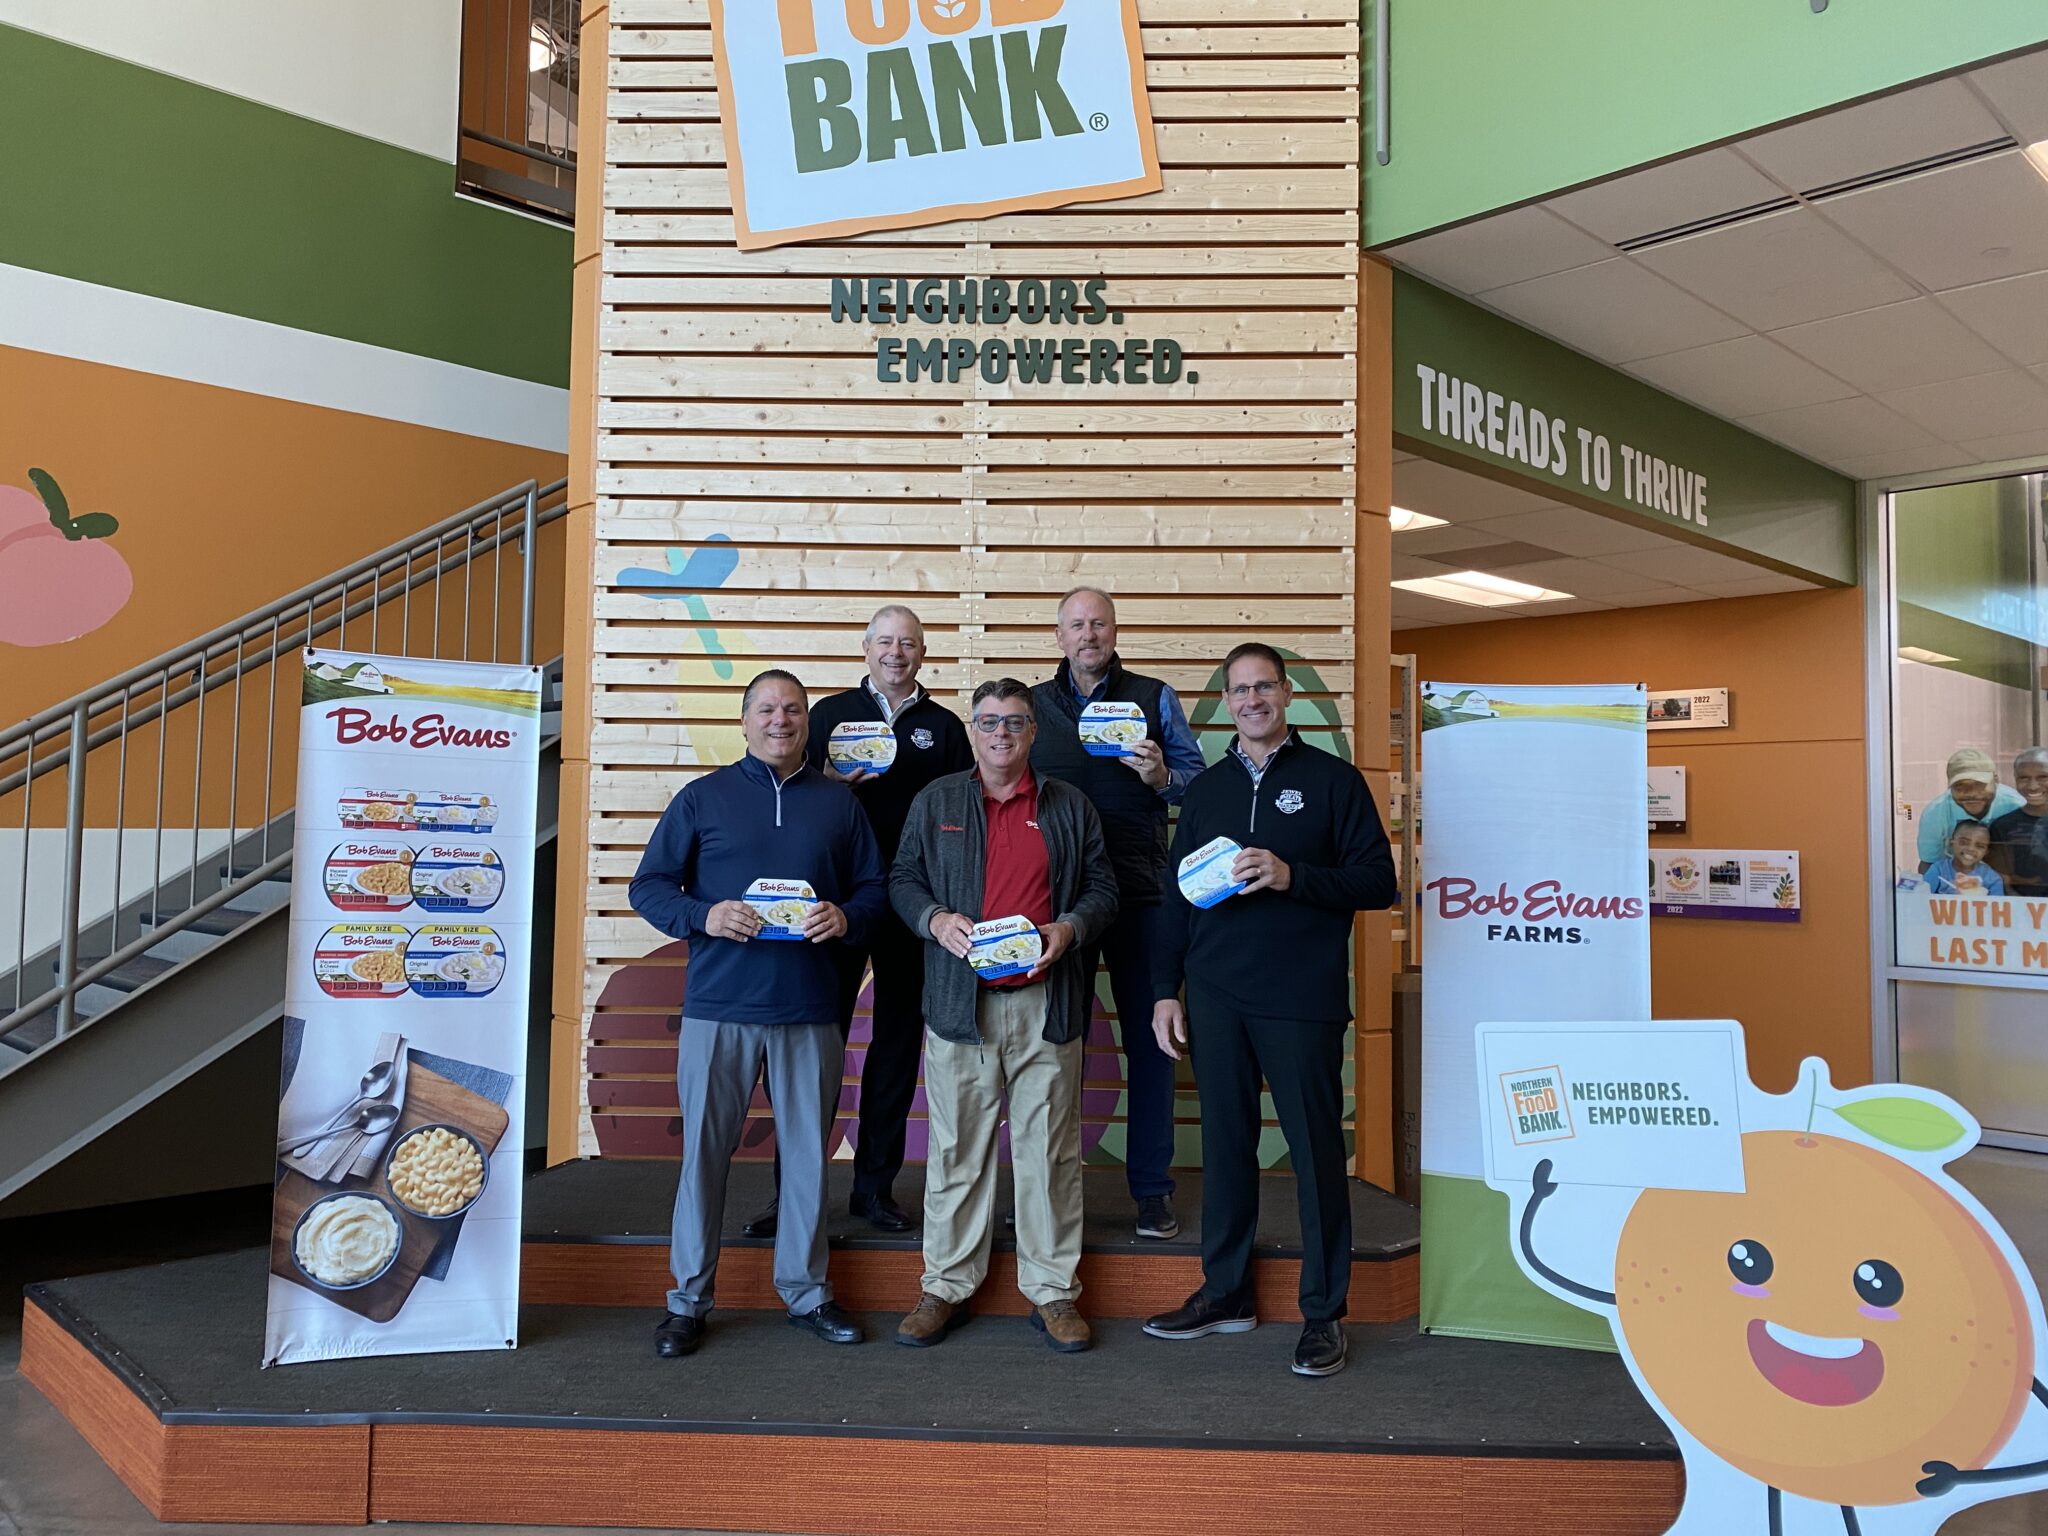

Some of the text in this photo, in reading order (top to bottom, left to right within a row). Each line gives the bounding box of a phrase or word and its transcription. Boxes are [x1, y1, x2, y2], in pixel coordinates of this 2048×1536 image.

[830, 278, 1124, 325] NEIGHBORS.
[876, 337, 1199, 385] EMPOWERED.
[1416, 363, 1708, 527] THREADS TO THRIVE
[1092, 705, 1129, 714] Bob Evans
[326, 707, 407, 744] Bob
[841, 725, 858, 733] Bob
[365, 790, 379, 798] Bob
[345, 844, 397, 856] Bob Evans
[430, 847, 480, 858] Bob Evans
[758, 882, 800, 892] Bob Evans
[1426, 876, 1644, 922] Bob Evans
[1666, 905, 1684, 914] 2022
[1929, 899, 2012, 928] WITH
[977, 923, 1018, 935] Bob Evans
[340, 935, 394, 946] Bob Evans
[430, 936, 480, 947] Bob Evans
[1930, 936, 2008, 966] LAST
[1510, 1077, 1553, 1092] NORTHERN
[1572, 1082, 1689, 1101] NEIGHBORS.
[1588, 1106, 1719, 1126] EMPOWERED.
